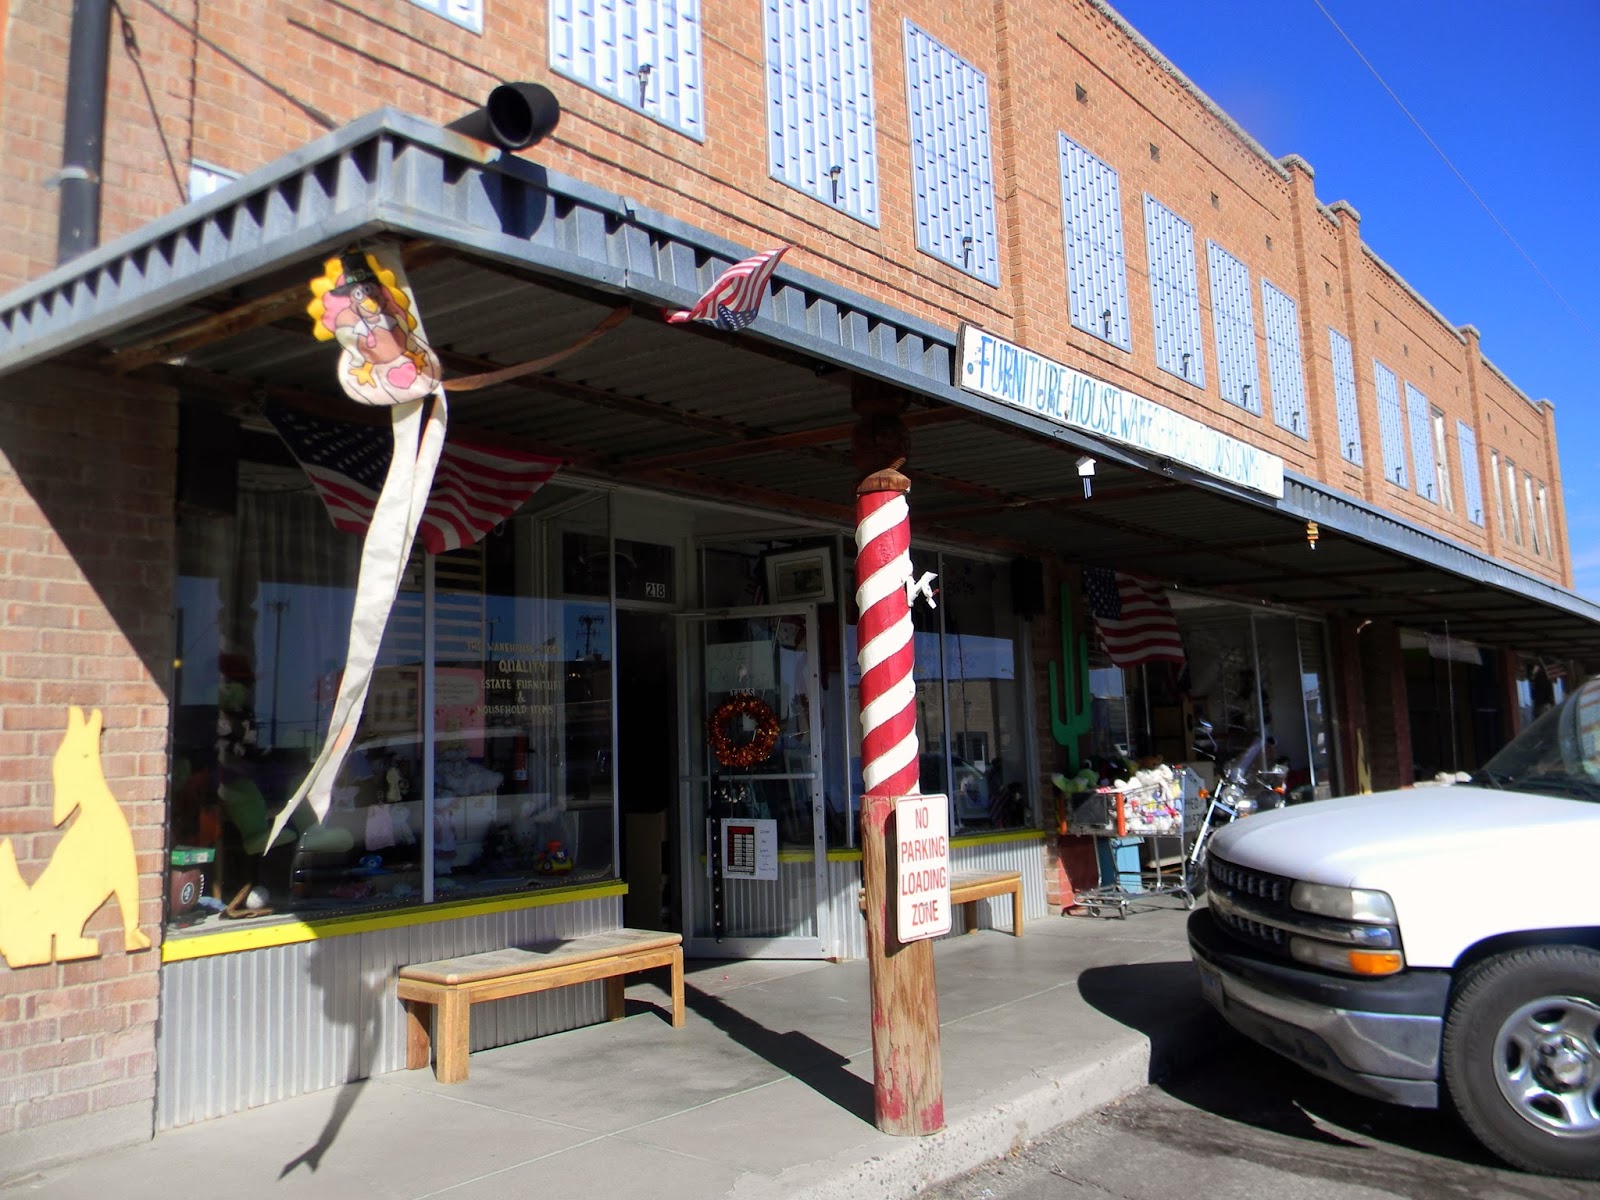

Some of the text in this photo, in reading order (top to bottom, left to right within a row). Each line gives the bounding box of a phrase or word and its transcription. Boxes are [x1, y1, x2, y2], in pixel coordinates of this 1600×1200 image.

[978, 335, 1066, 418] FURNITURE
[646, 583, 665, 598] 218
[499, 660, 546, 674] QUALITY
[481, 679, 512, 690] ESTATE
[517, 691, 526, 703] &
[477, 705, 554, 715] HOUSEHOLD ITEMS
[915, 806, 929, 830] NO
[901, 836, 946, 864] PARKING
[902, 867, 946, 896] LOADING
[911, 900, 939, 926] ZONE
